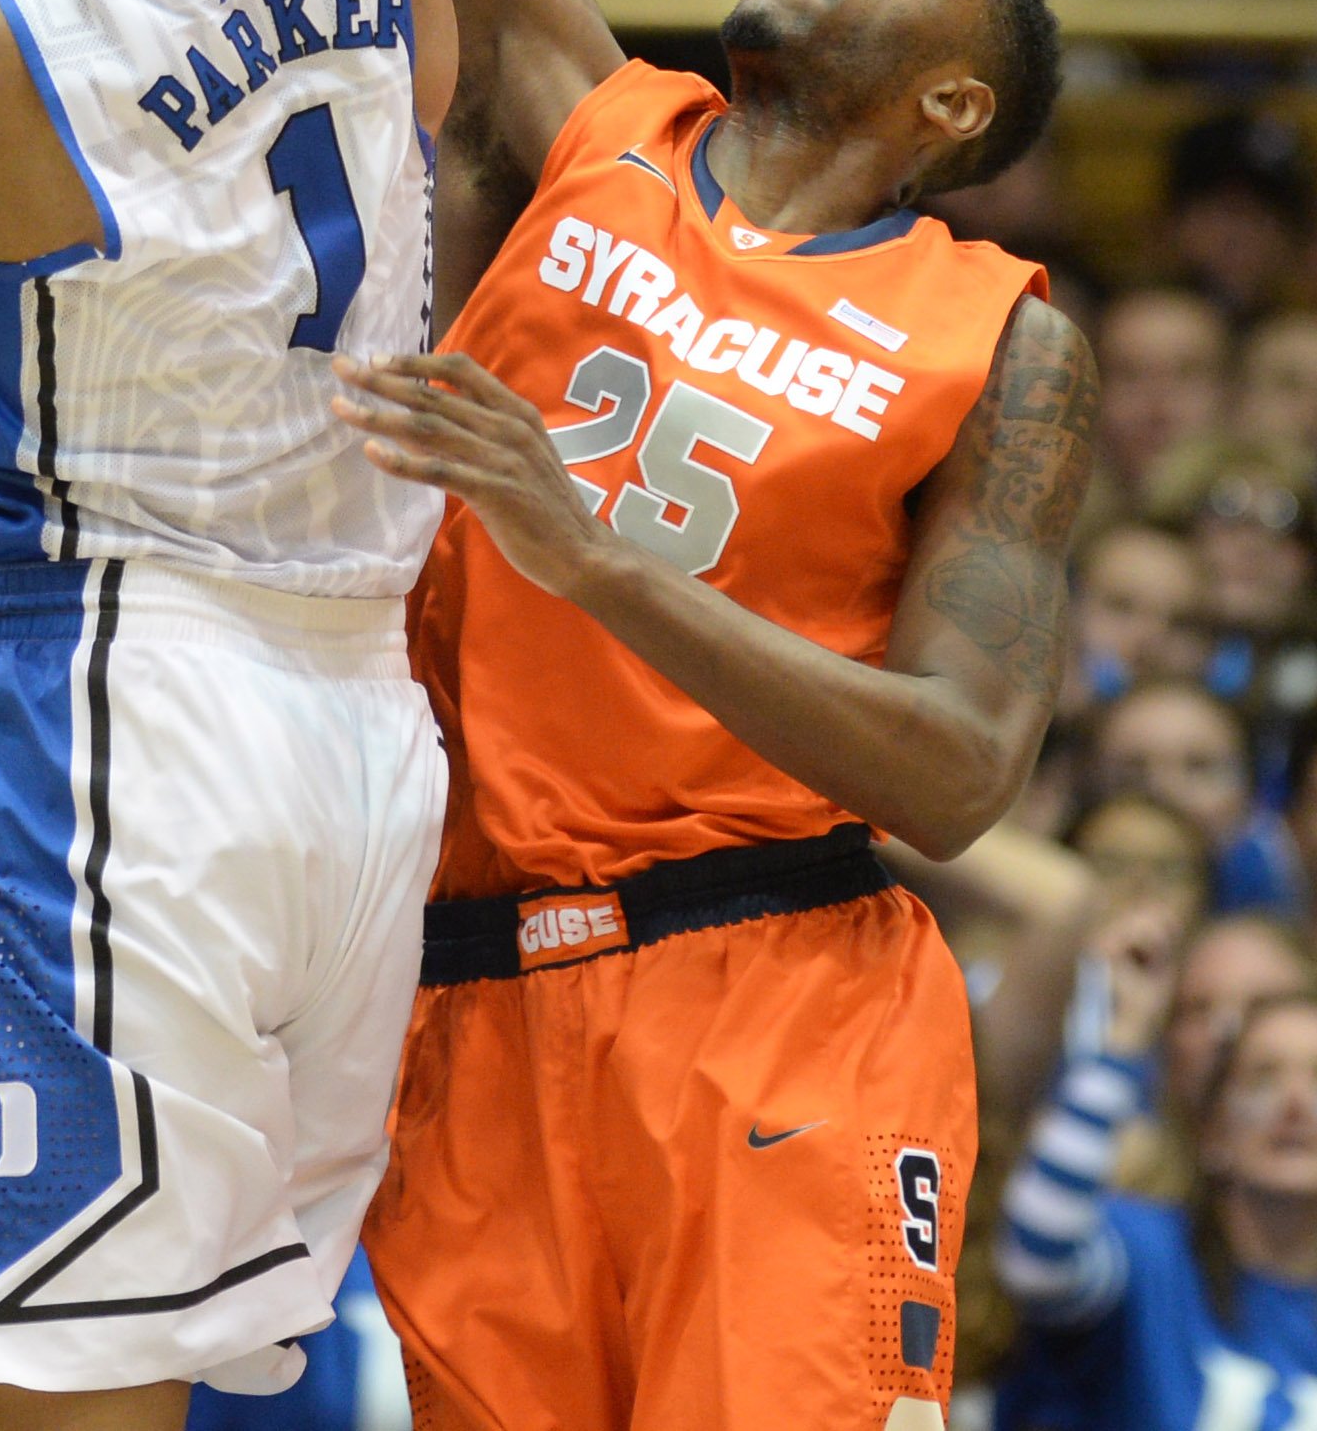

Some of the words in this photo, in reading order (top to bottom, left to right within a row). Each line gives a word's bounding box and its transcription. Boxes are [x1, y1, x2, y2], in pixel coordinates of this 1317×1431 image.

[266, 102, 366, 353] 1
[539, 216, 905, 442] SYRACUSE
[546, 345, 774, 576] 25
[521, 905, 619, 954] CUSE
[894, 1147, 941, 1273] S
